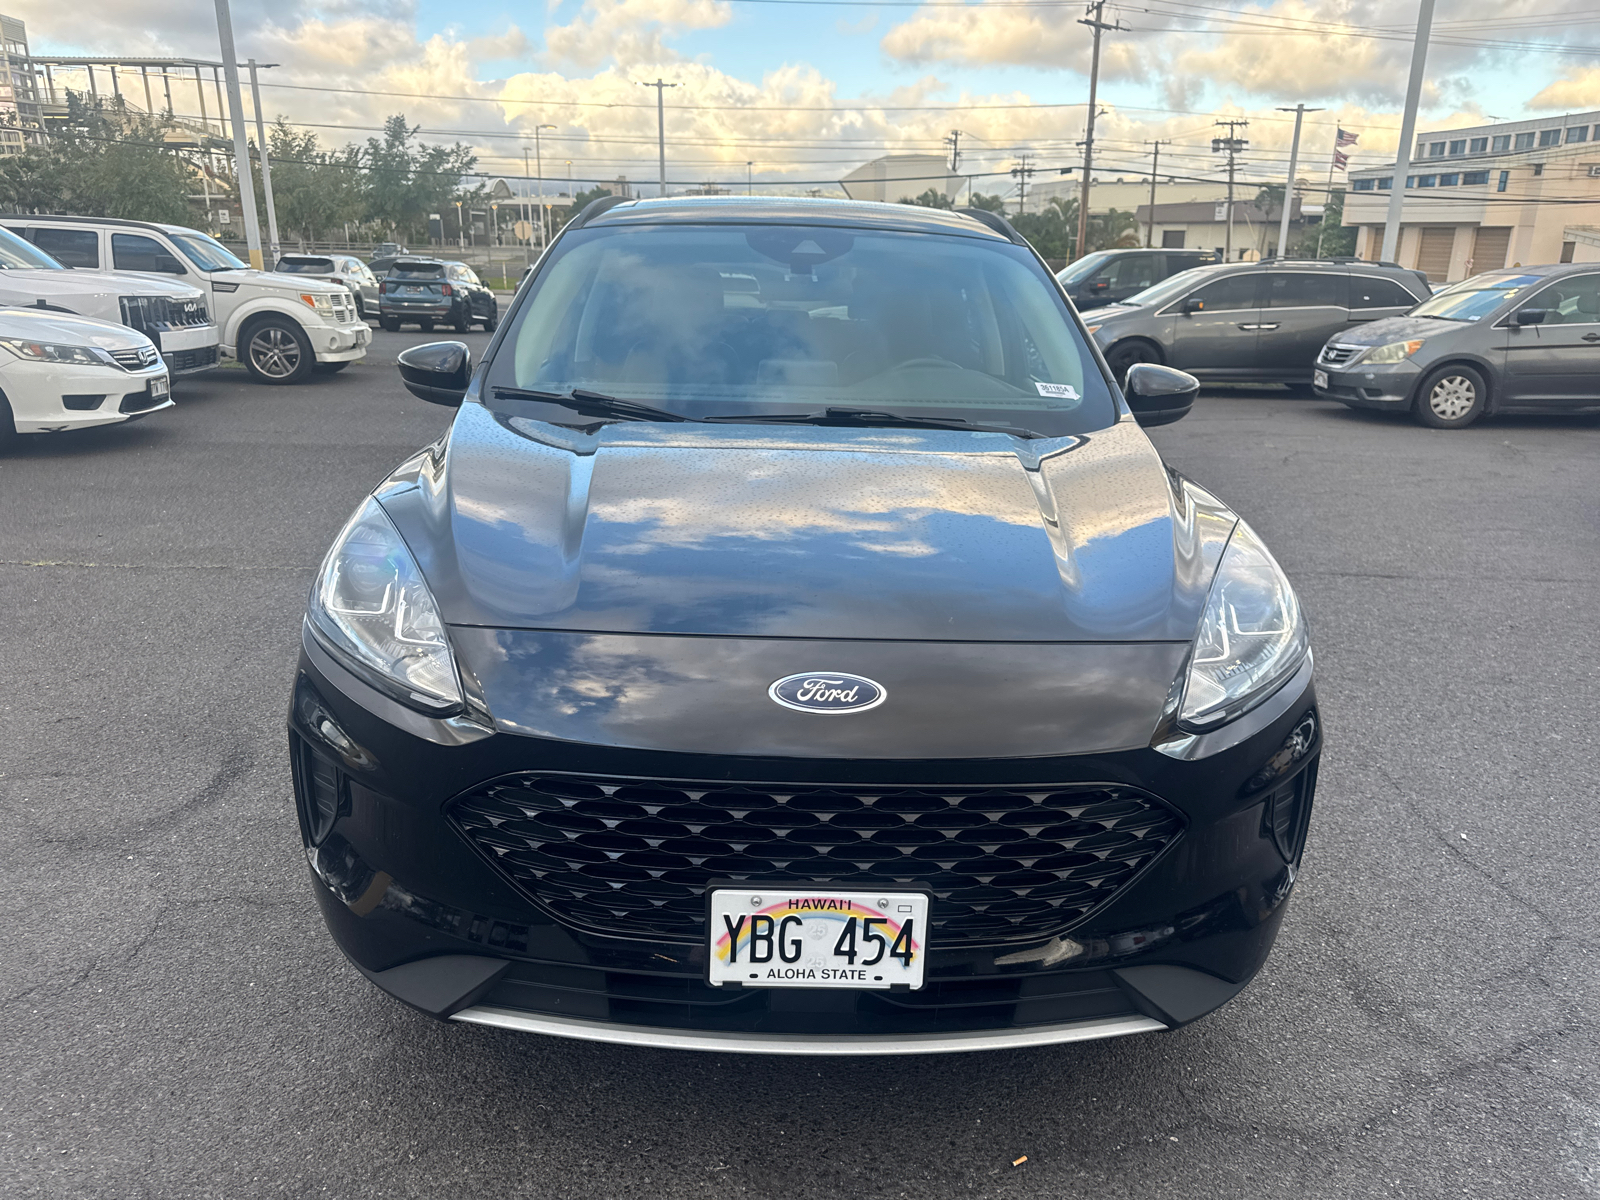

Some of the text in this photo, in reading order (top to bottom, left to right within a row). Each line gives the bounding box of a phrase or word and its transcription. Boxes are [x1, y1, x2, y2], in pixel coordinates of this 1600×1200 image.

[796, 678, 859, 702] Ford
[723, 914, 914, 967] YBG 454
[767, 968, 867, 981] ALOHA STATE
